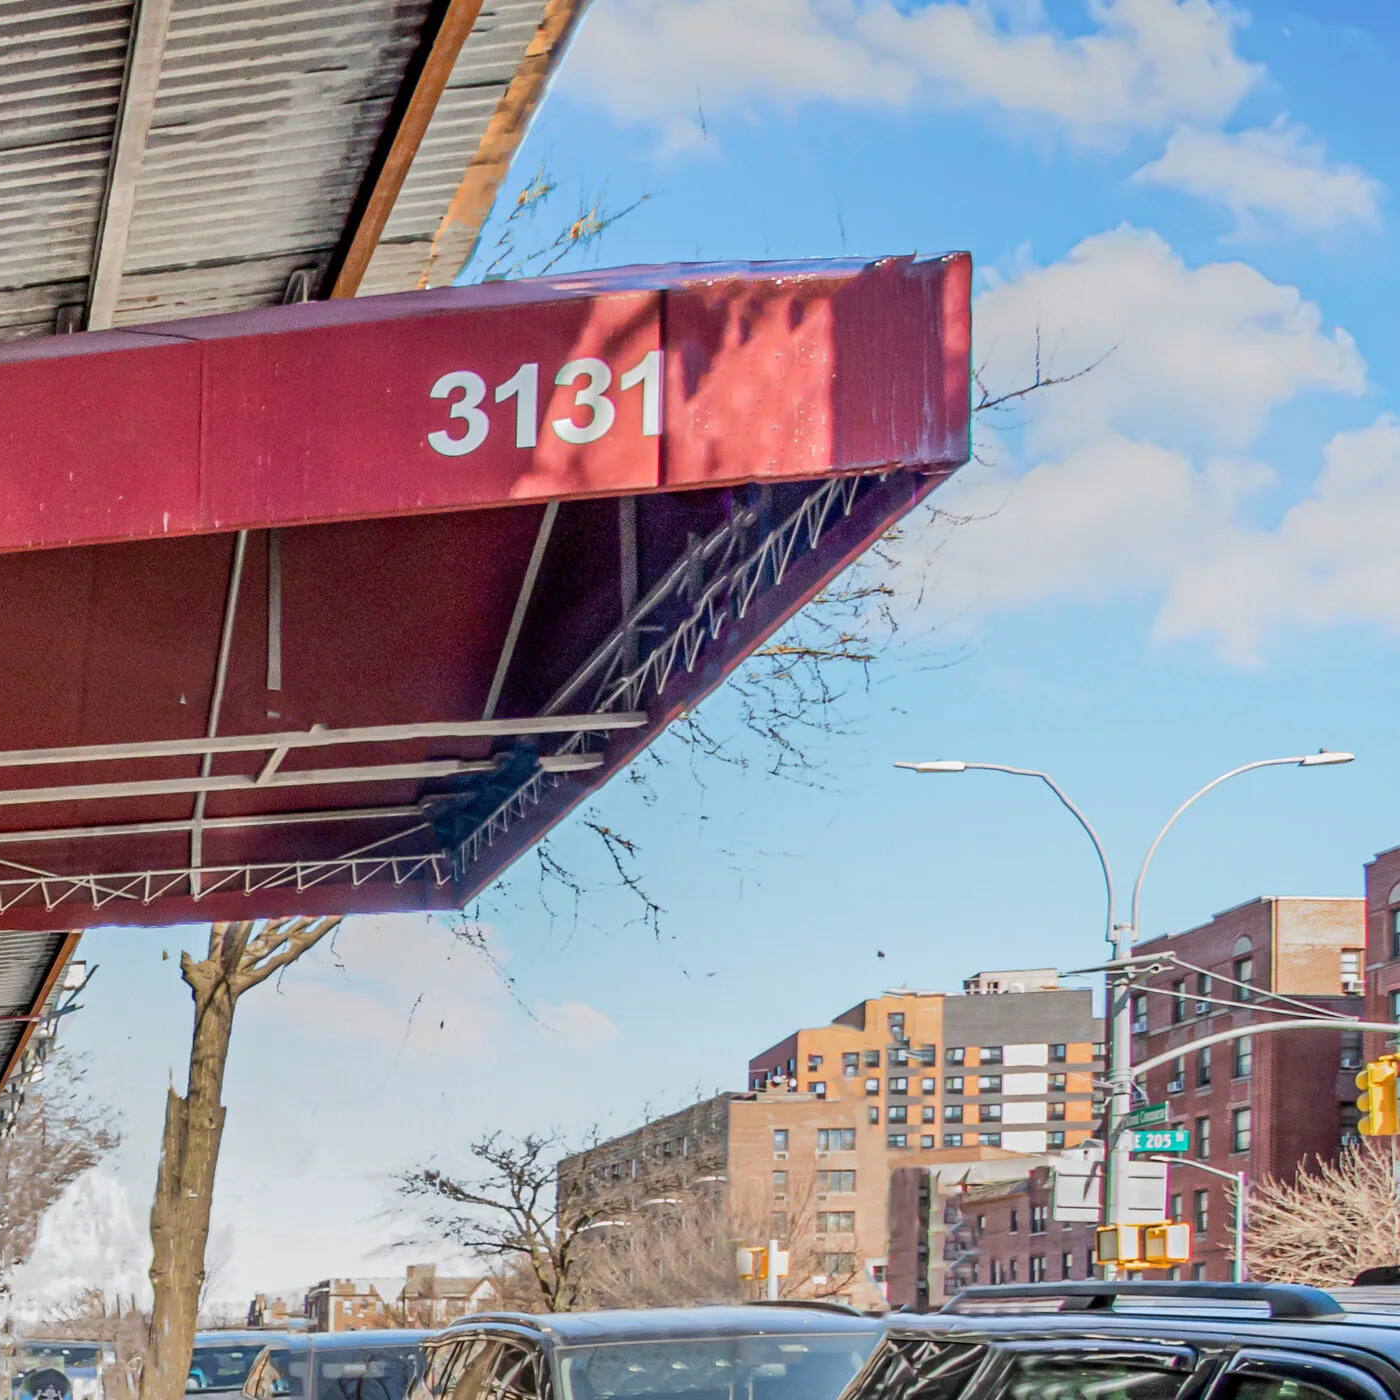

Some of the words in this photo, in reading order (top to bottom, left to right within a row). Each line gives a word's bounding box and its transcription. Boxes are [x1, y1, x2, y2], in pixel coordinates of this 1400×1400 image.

[427, 349, 664, 458] 3131
[1133, 1133, 1142, 1149] E
[1145, 1133, 1172, 1149] 205
